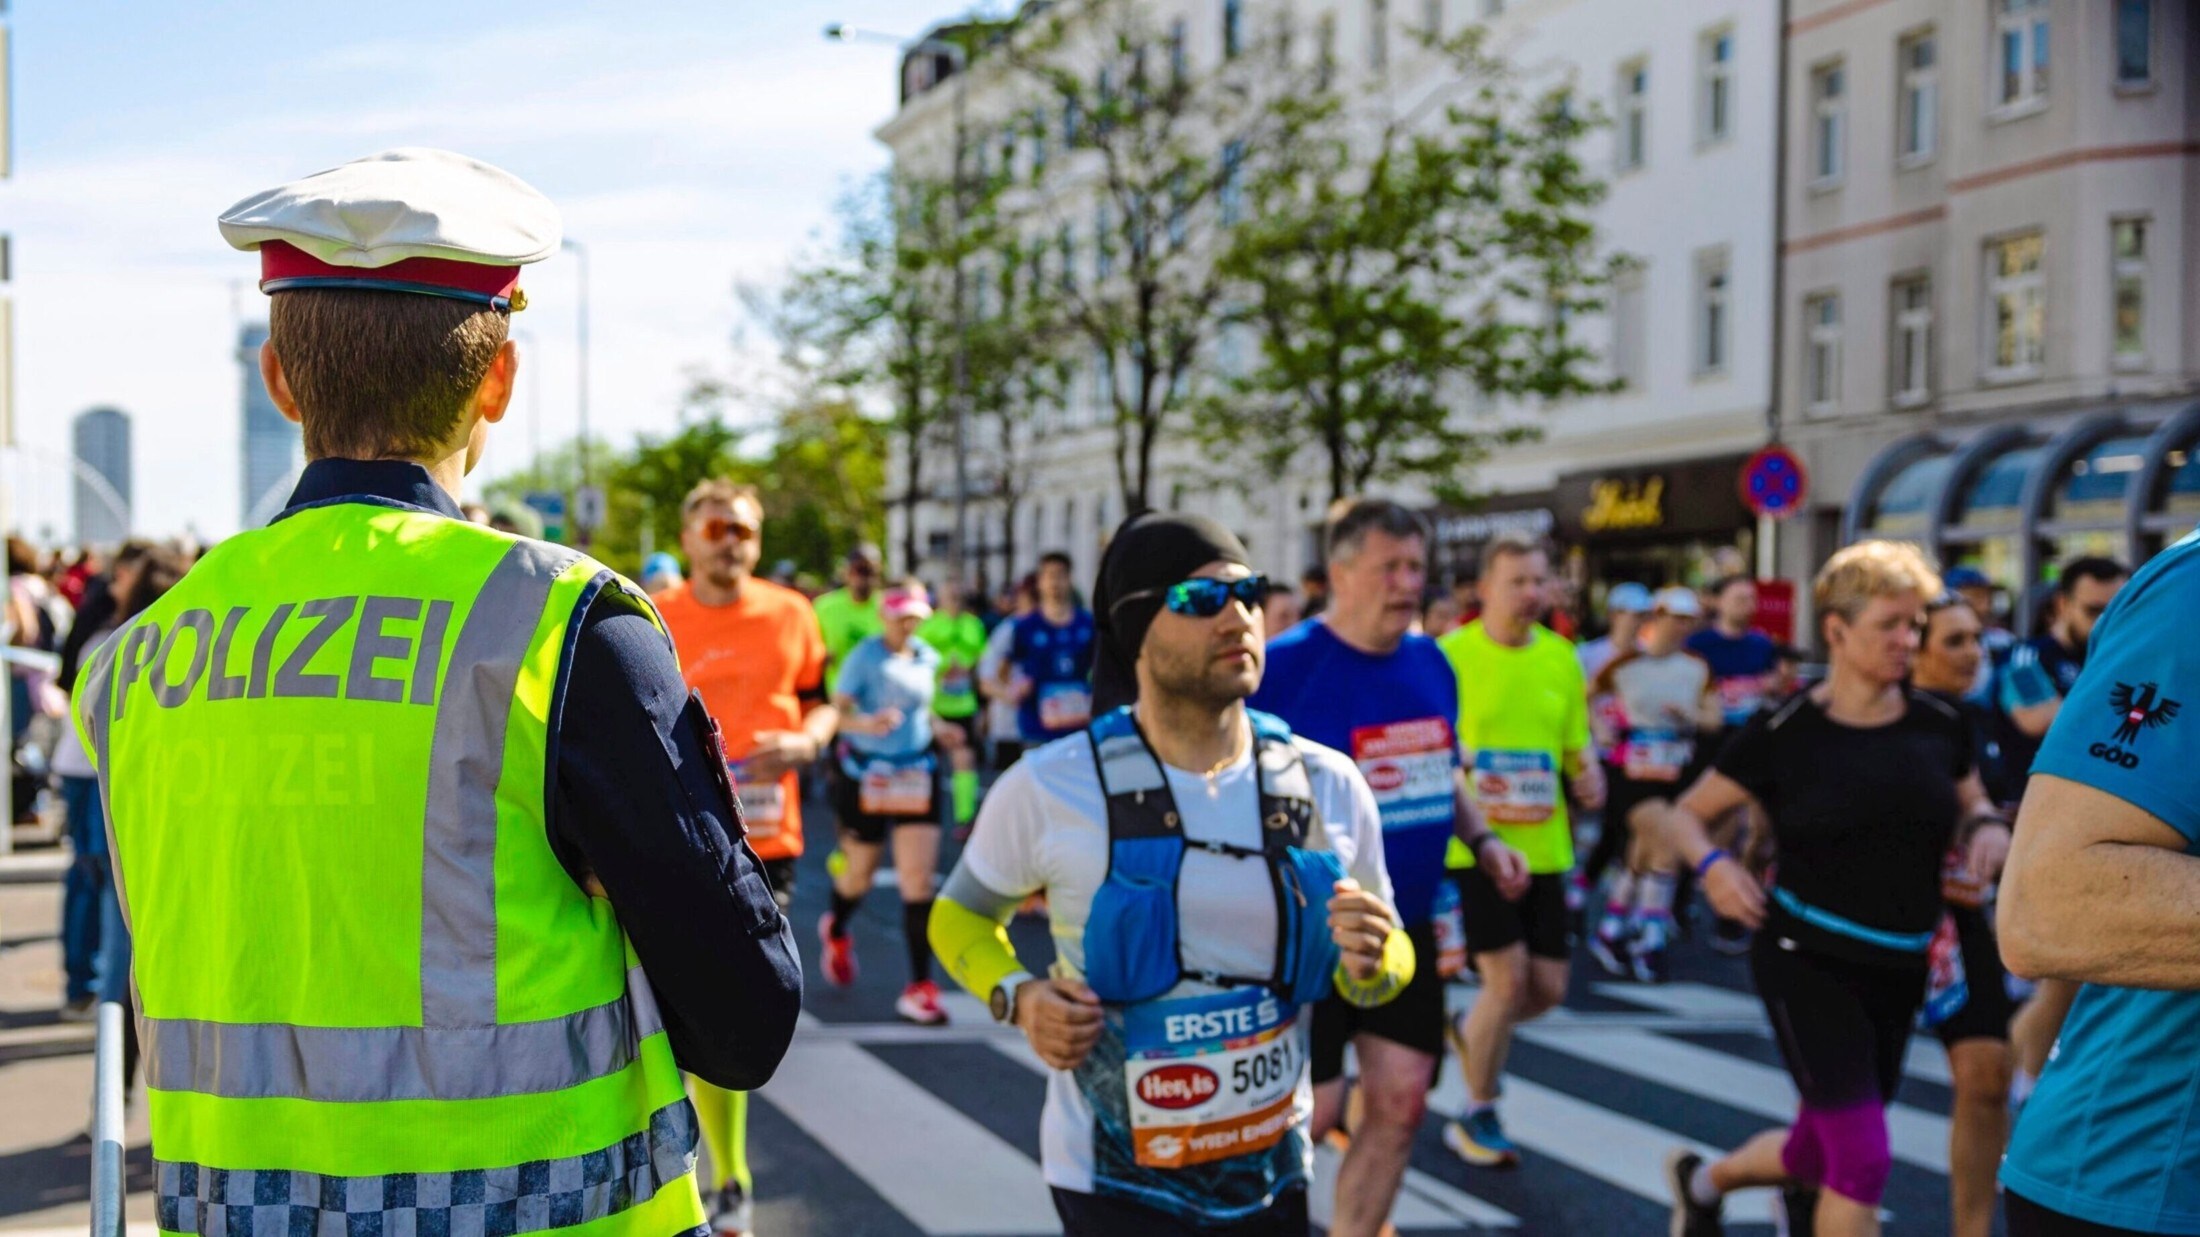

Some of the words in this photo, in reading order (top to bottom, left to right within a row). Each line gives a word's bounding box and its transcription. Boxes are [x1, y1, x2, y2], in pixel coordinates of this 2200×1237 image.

[113, 595, 455, 722] POLIZEI
[2089, 742, 2139, 770] GÖD
[1165, 1005, 1253, 1042] ERSTE
[1143, 1073, 1215, 1101] Hervis
